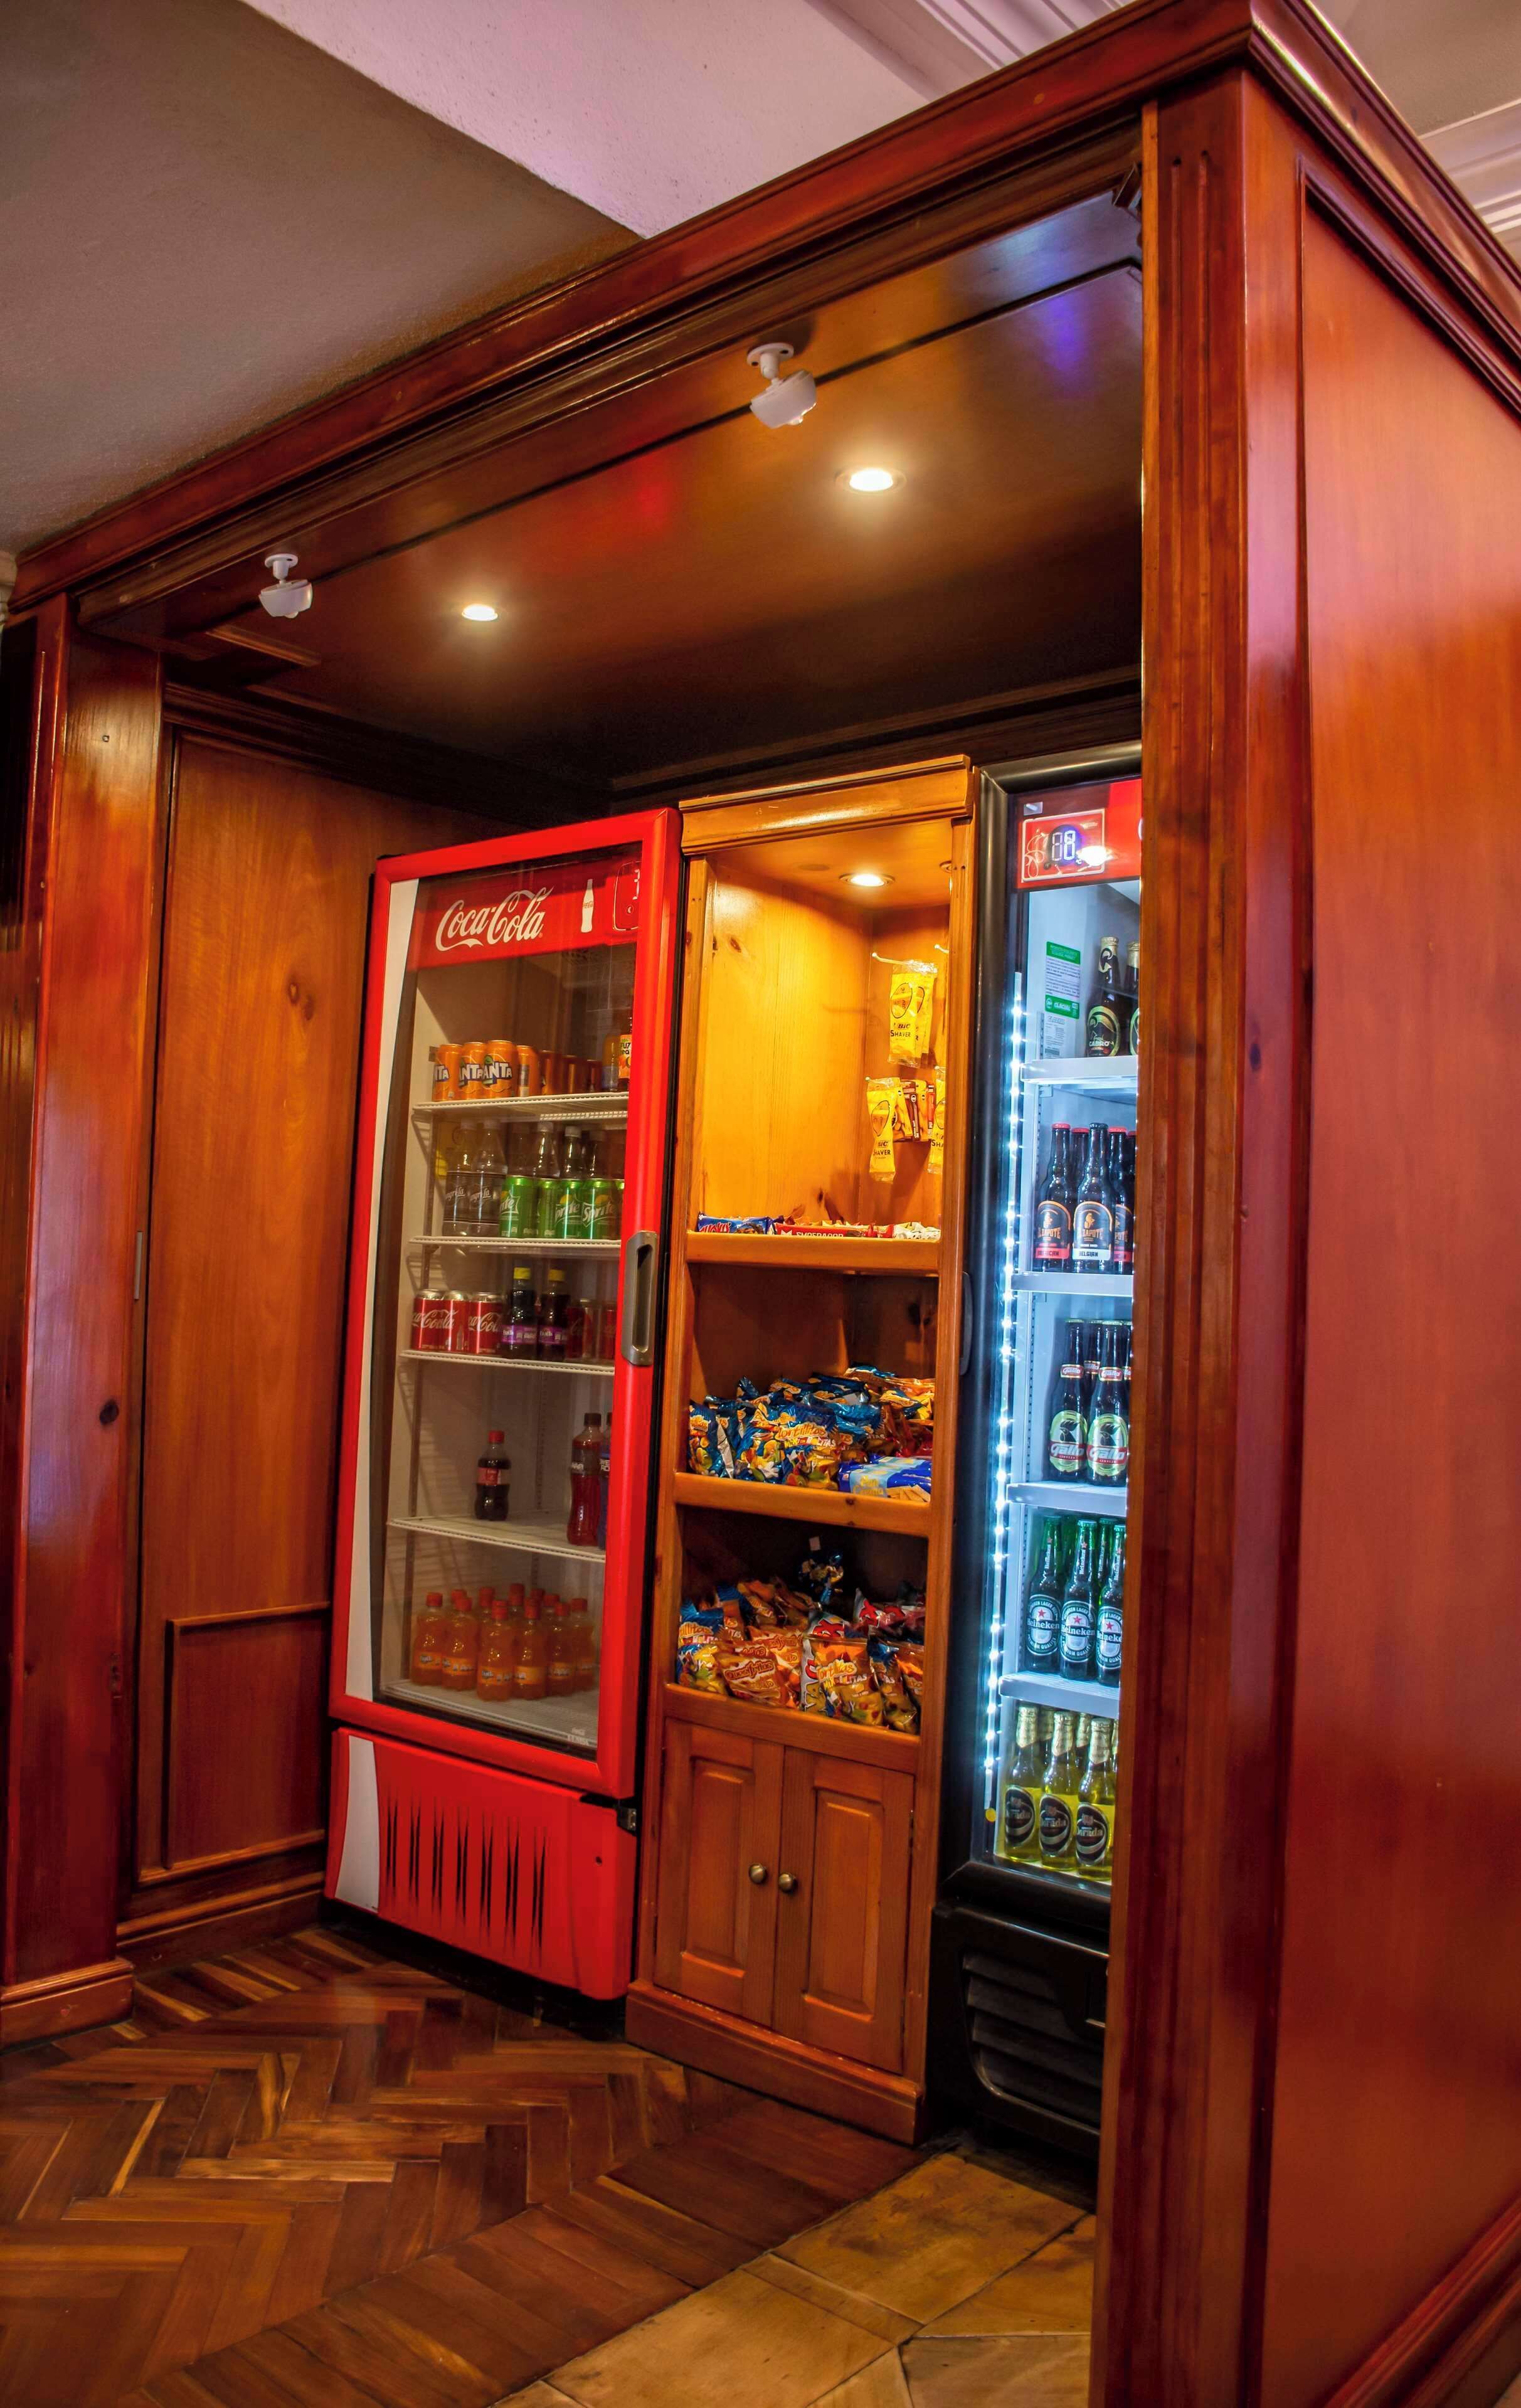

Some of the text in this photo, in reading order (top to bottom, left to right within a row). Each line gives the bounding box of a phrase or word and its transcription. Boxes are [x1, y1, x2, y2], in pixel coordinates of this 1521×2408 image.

[436, 886, 554, 952] Coca-Cola
[1051, 1442, 1084, 1456] Gallo
[1089, 1446, 1125, 1463] Gallo
[1027, 1618, 1060, 1629] Heineken
[1061, 1624, 1095, 1636] Heineken
